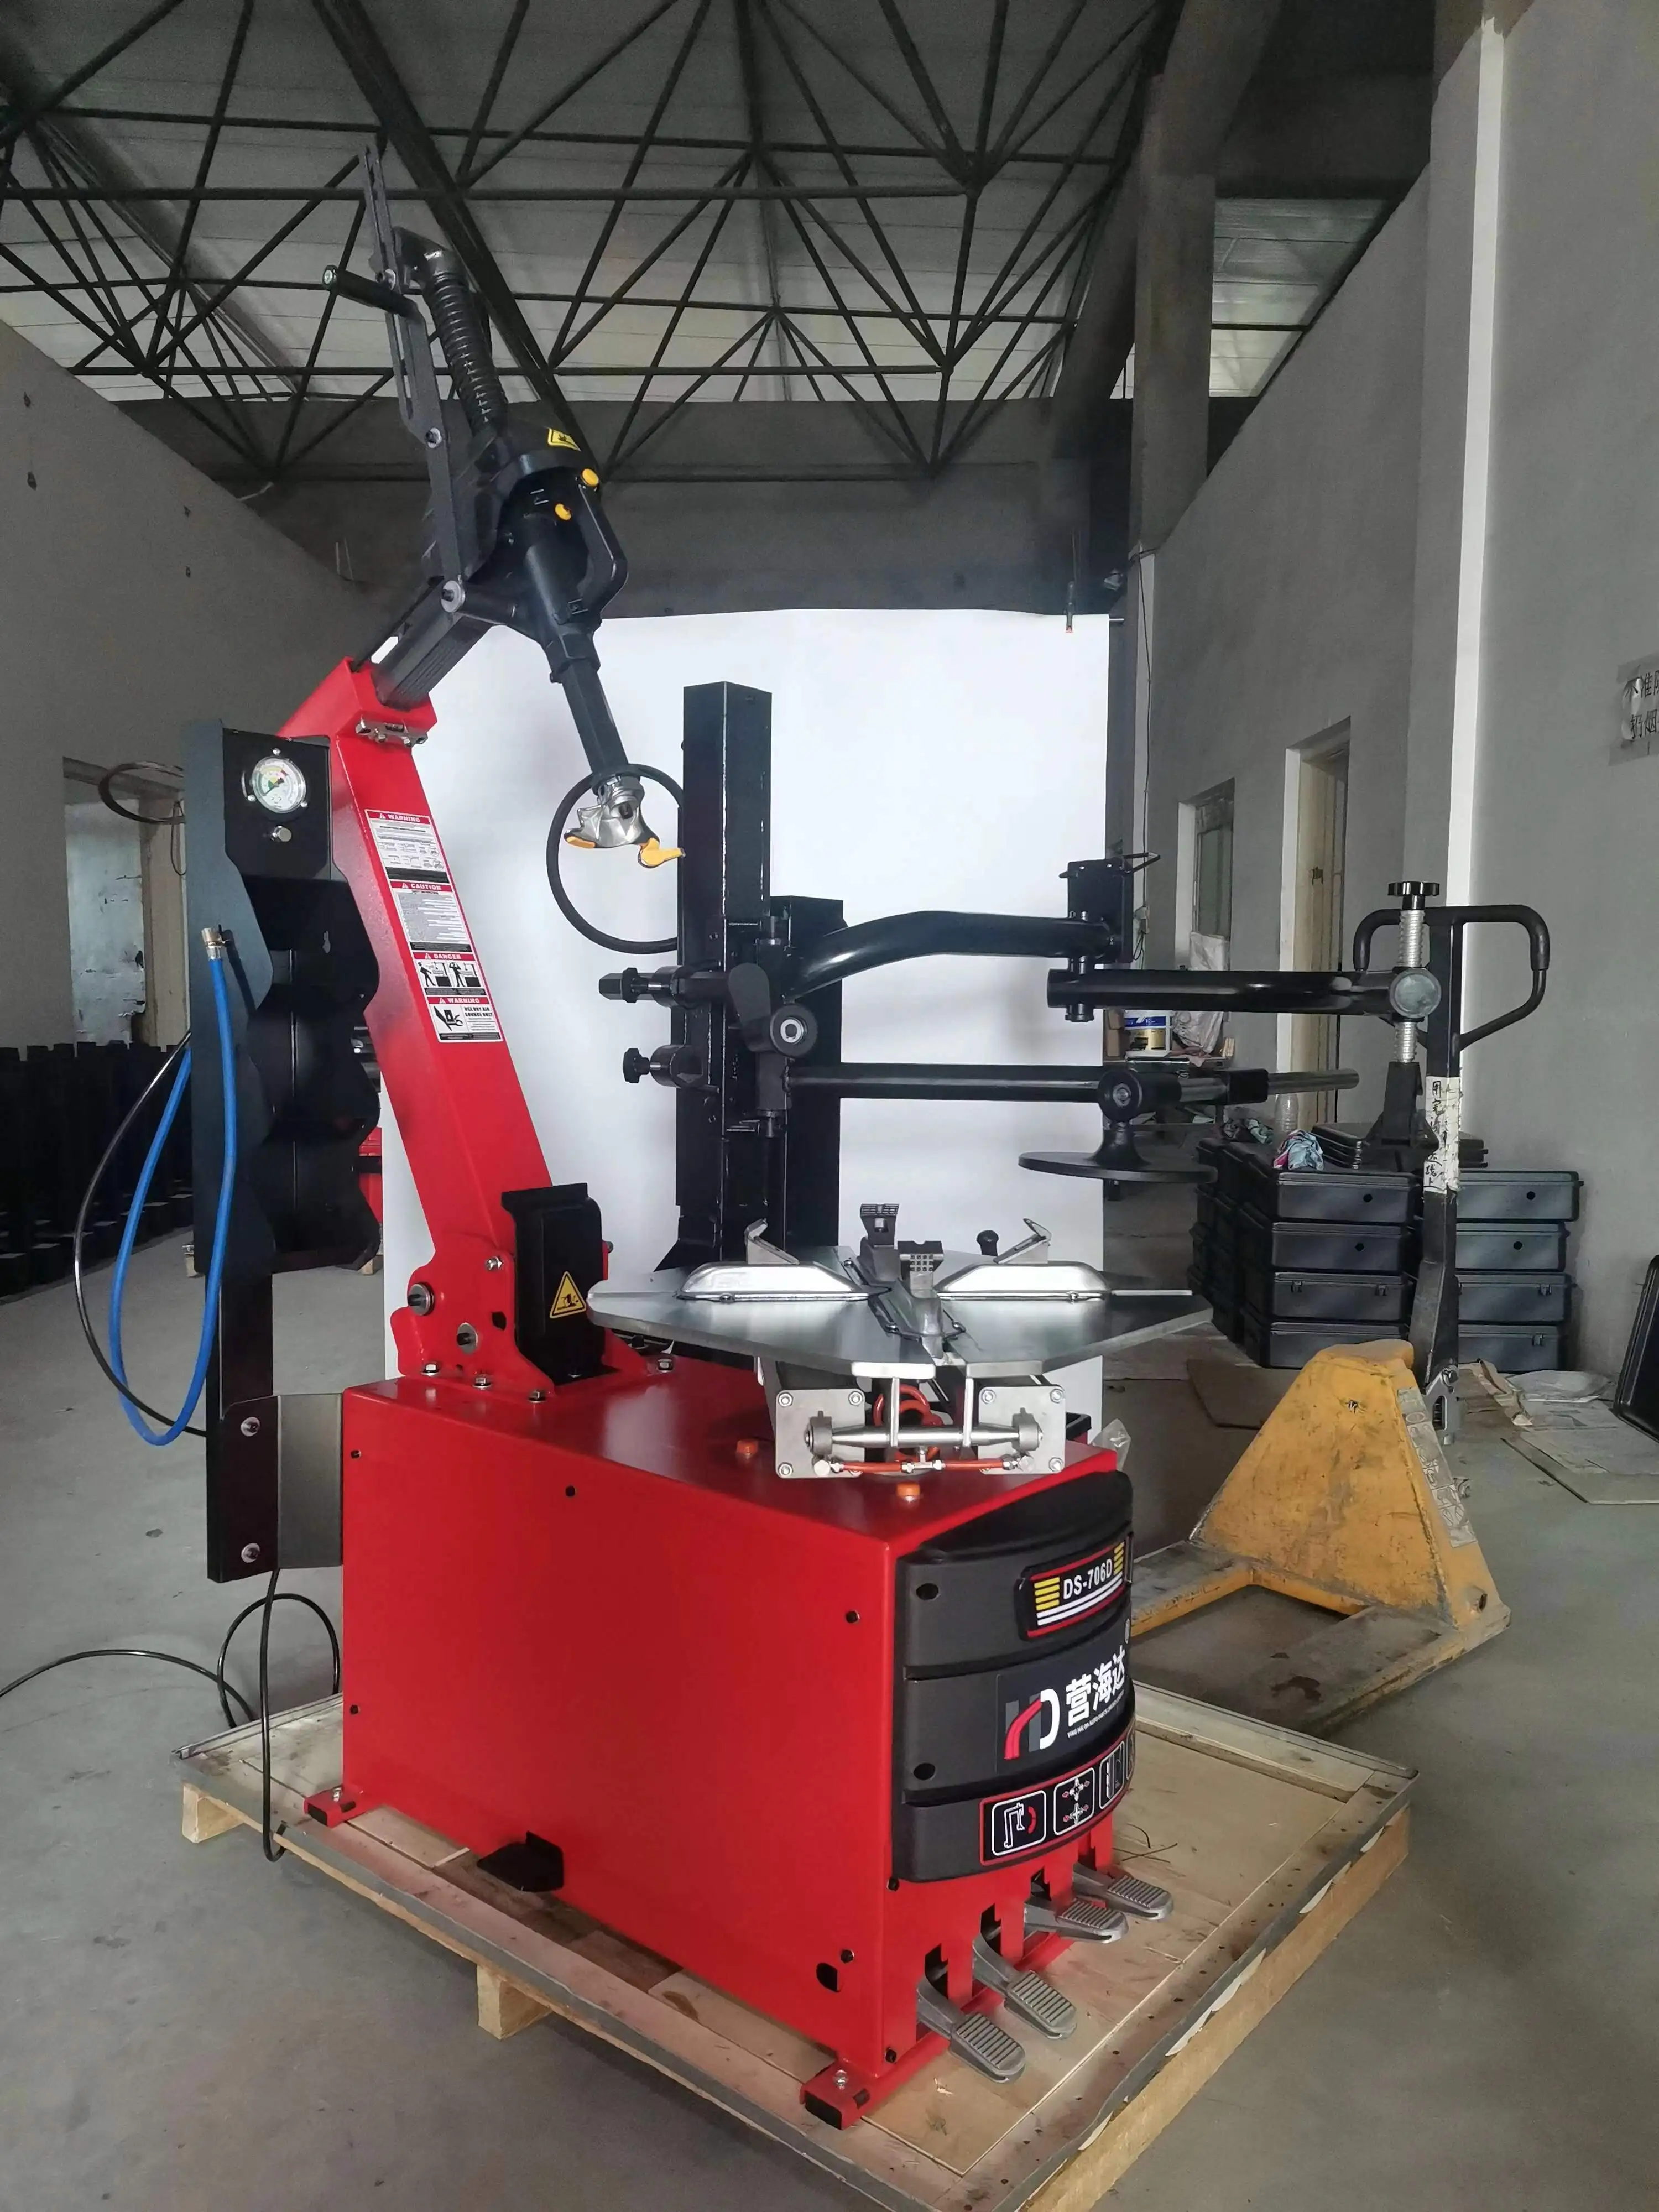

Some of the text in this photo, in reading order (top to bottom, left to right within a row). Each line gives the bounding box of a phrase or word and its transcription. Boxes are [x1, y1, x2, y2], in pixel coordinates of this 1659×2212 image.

[1630, 709, 1659, 739] 扔烟
[387, 813, 421, 822] WARNING
[1063, 1558, 1112, 1599] DS-706D
[1065, 1645, 1125, 1727] 营海达
